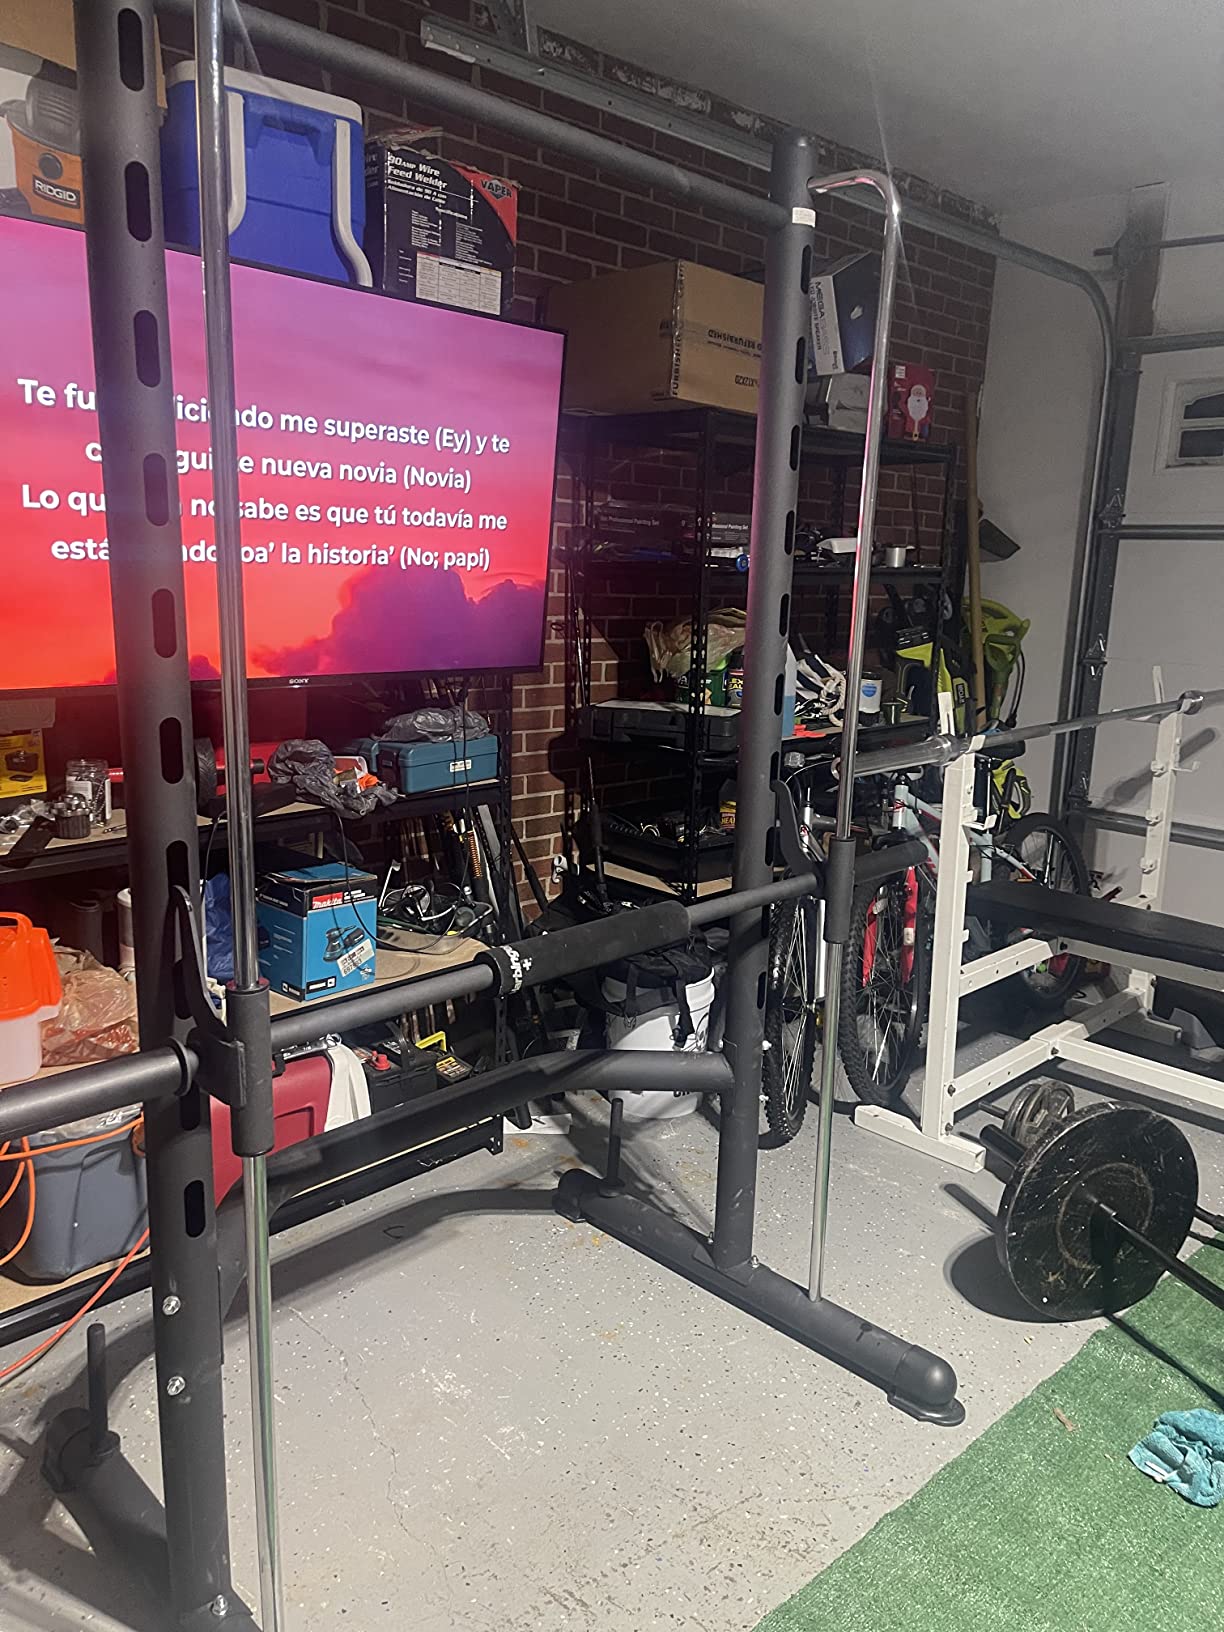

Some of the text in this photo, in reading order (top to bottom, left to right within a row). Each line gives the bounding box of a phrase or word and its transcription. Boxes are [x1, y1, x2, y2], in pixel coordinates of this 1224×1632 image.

[388, 164, 448, 189] Feed Welder
[419, 163, 441, 178] Wire
[35, 179, 77, 202] RIDGID
[480, 179, 512, 198] VAPER
[17, 378, 56, 406] Te
[280, 410, 318, 434] me
[323, 416, 430, 446] superaste
[434, 425, 472, 454] (Ey)
[475, 434, 488, 455] y
[491, 434, 511, 453] te
[261, 455, 333, 480] nueva
[339, 461, 398, 484] novia
[403, 464, 472, 494] (Novia)
[22, 483, 60, 511] Lo
[67, 490, 107, 517] qu
[295, 502, 322, 522] es
[326, 506, 369, 528] que
[374, 504, 397, 526] tú
[402, 507, 474, 529] todavía
[478, 512, 508, 530] me
[281, 542, 302, 564] la
[400, 546, 440, 570] (No;
[443, 548, 491, 571] papi)
[312, 897, 343, 909] makita
